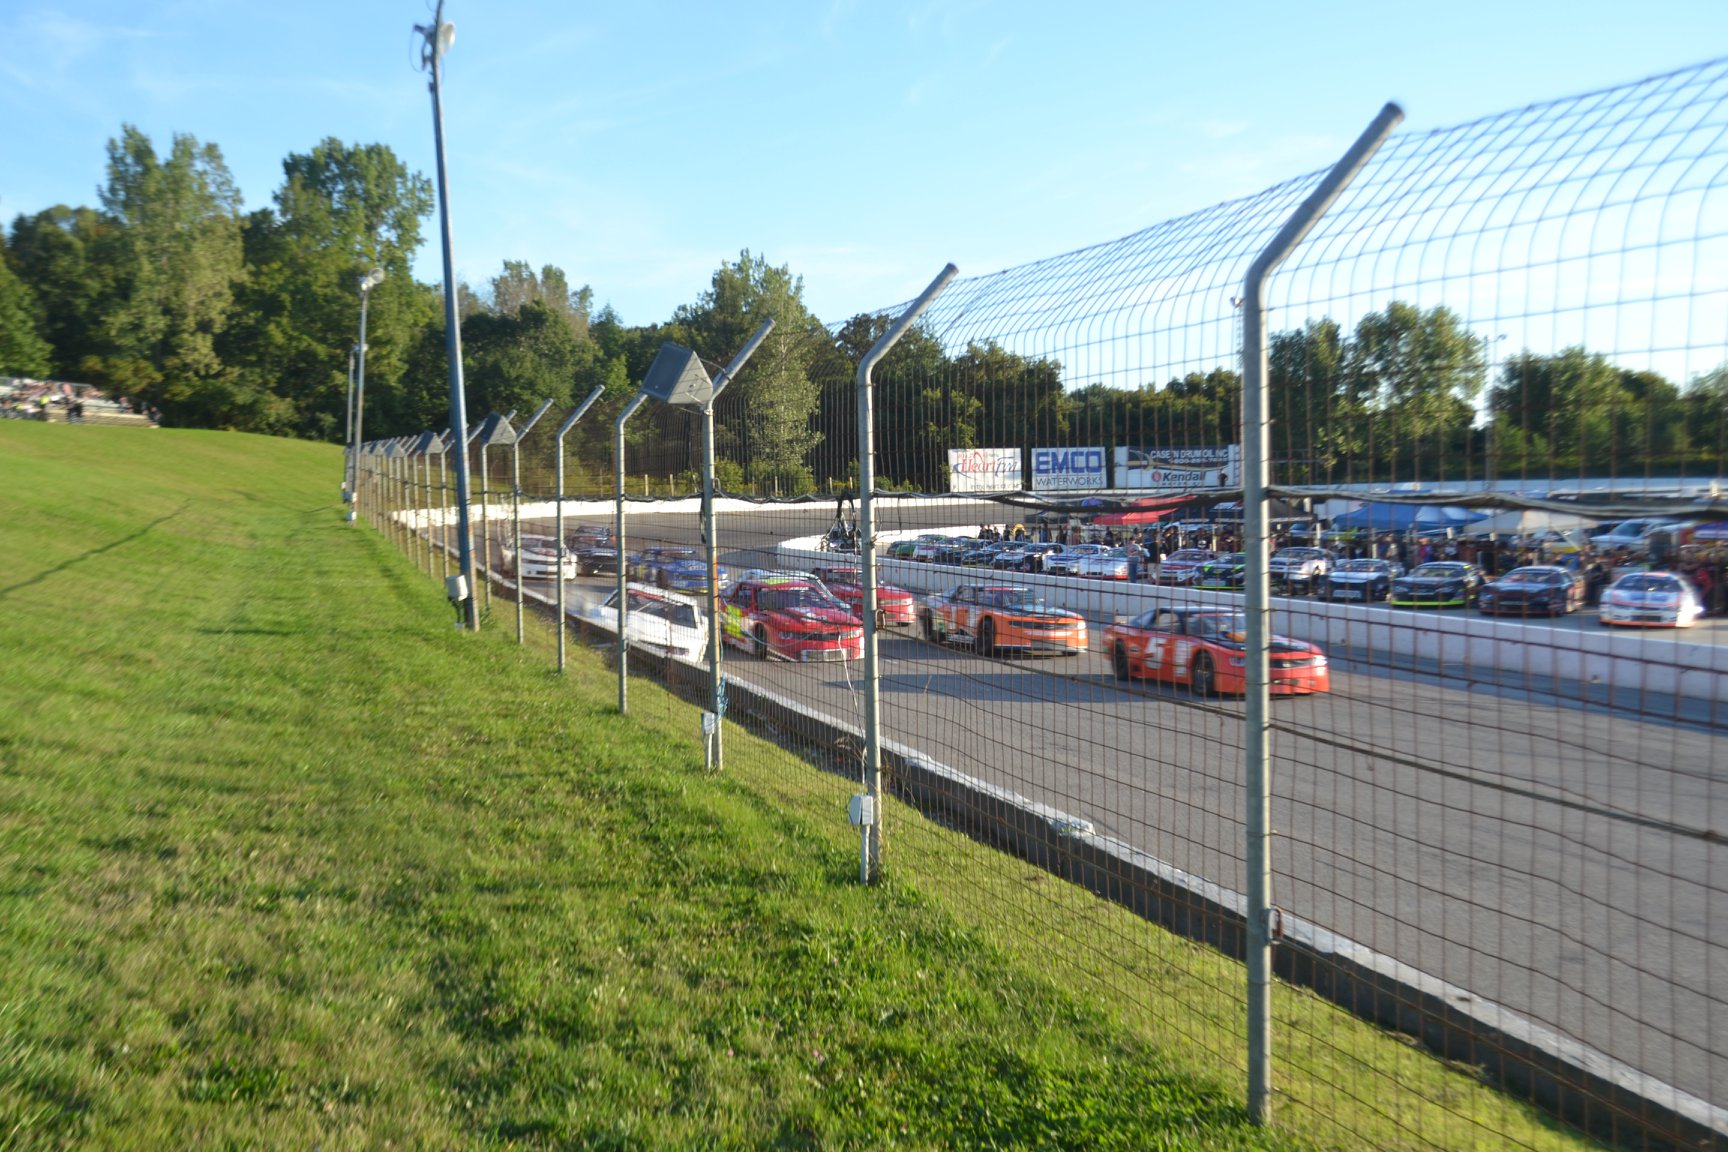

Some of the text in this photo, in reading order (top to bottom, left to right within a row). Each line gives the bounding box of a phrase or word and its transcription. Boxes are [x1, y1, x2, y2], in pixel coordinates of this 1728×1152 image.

[1036, 451, 1102, 474] EMCO
[1037, 477, 1103, 486] WATERWORKS
[1162, 470, 1207, 482] Kendall
